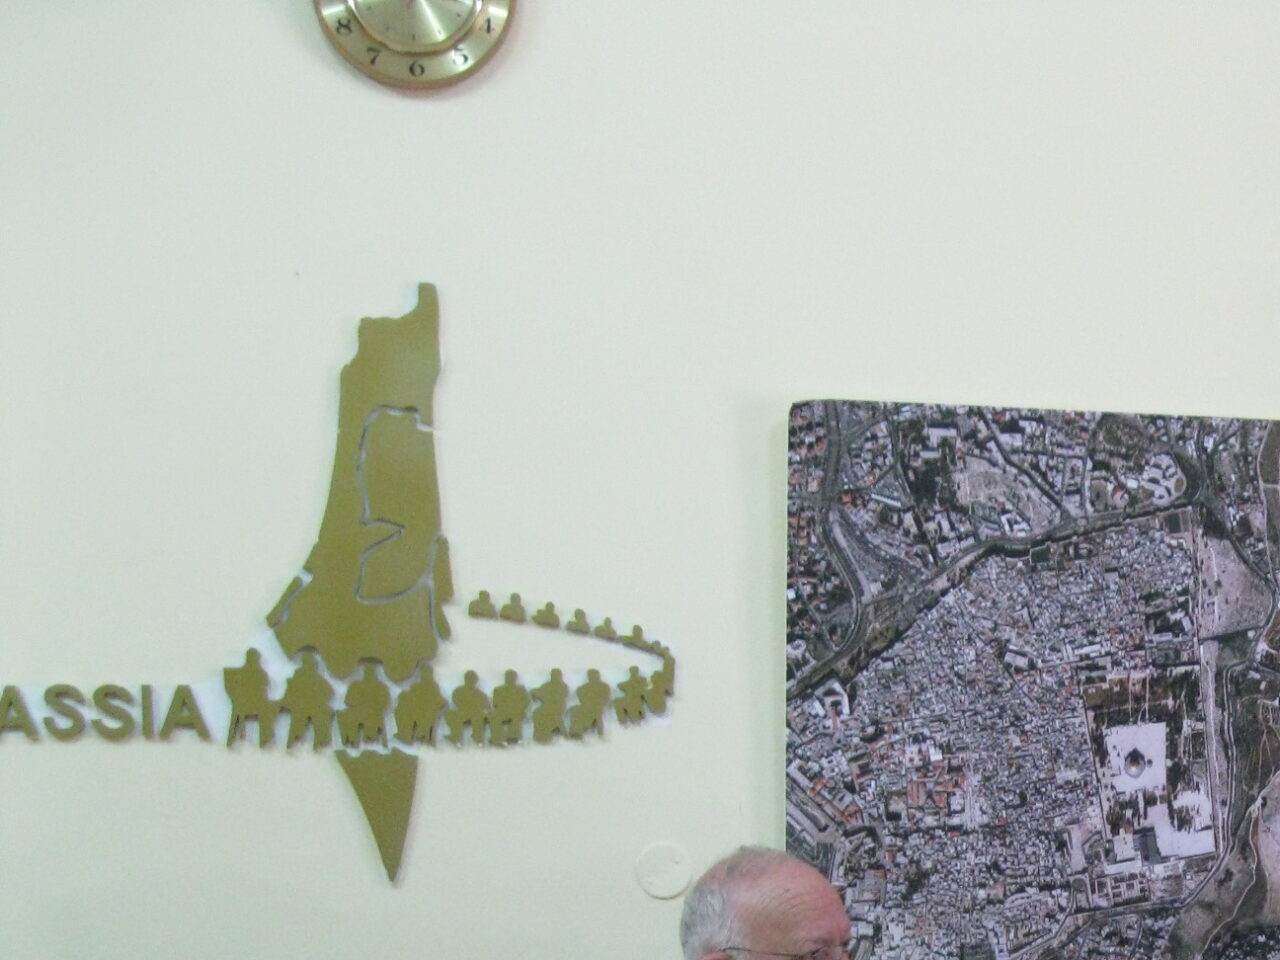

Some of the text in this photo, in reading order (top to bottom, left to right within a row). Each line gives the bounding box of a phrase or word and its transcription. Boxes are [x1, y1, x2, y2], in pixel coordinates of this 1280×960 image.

[336, 18, 352, 34] 8
[367, 47, 381, 65] 7
[453, 46, 468, 66] 5
[409, 60, 424, 77] 6
[0, 683, 217, 743] ASSIA
